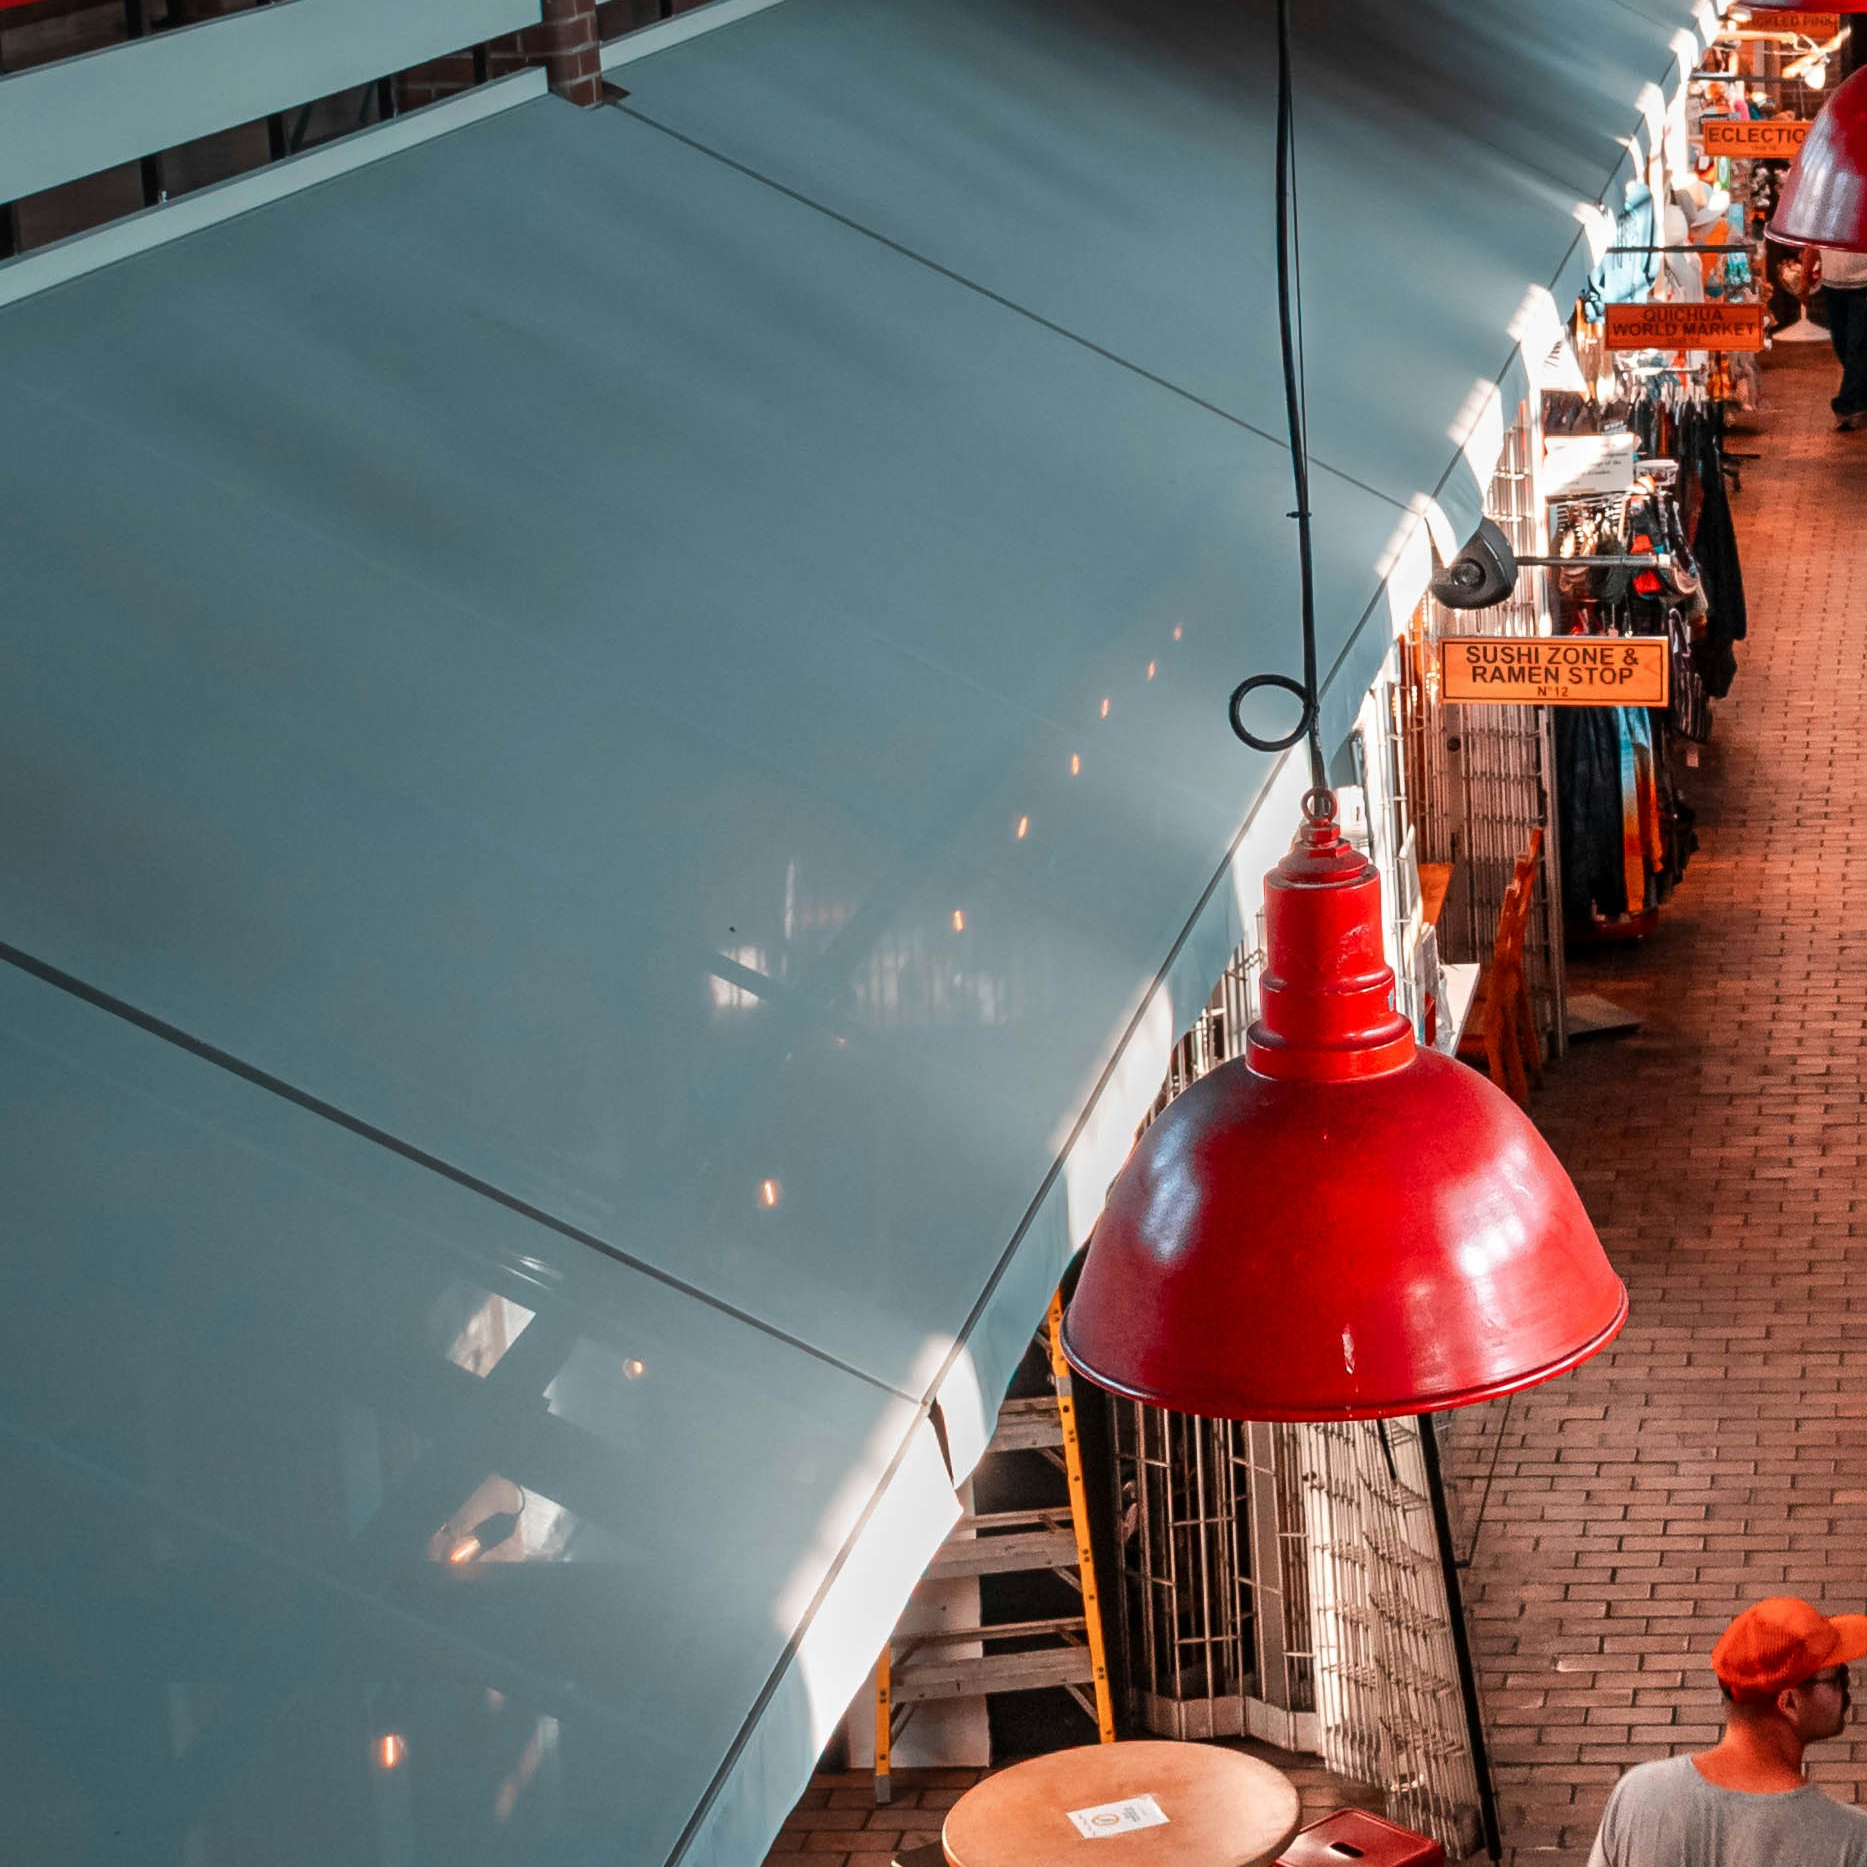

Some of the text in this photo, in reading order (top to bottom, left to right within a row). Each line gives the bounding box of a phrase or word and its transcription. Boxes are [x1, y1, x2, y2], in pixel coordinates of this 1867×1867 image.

[1643, 308, 1724, 322] QUICHUA
[1612, 322, 1756, 336] WORLD MARKET
[1466, 645, 1639, 666] SUSHI ZONE &
[1471, 665, 1634, 685] RAMEN STOP
